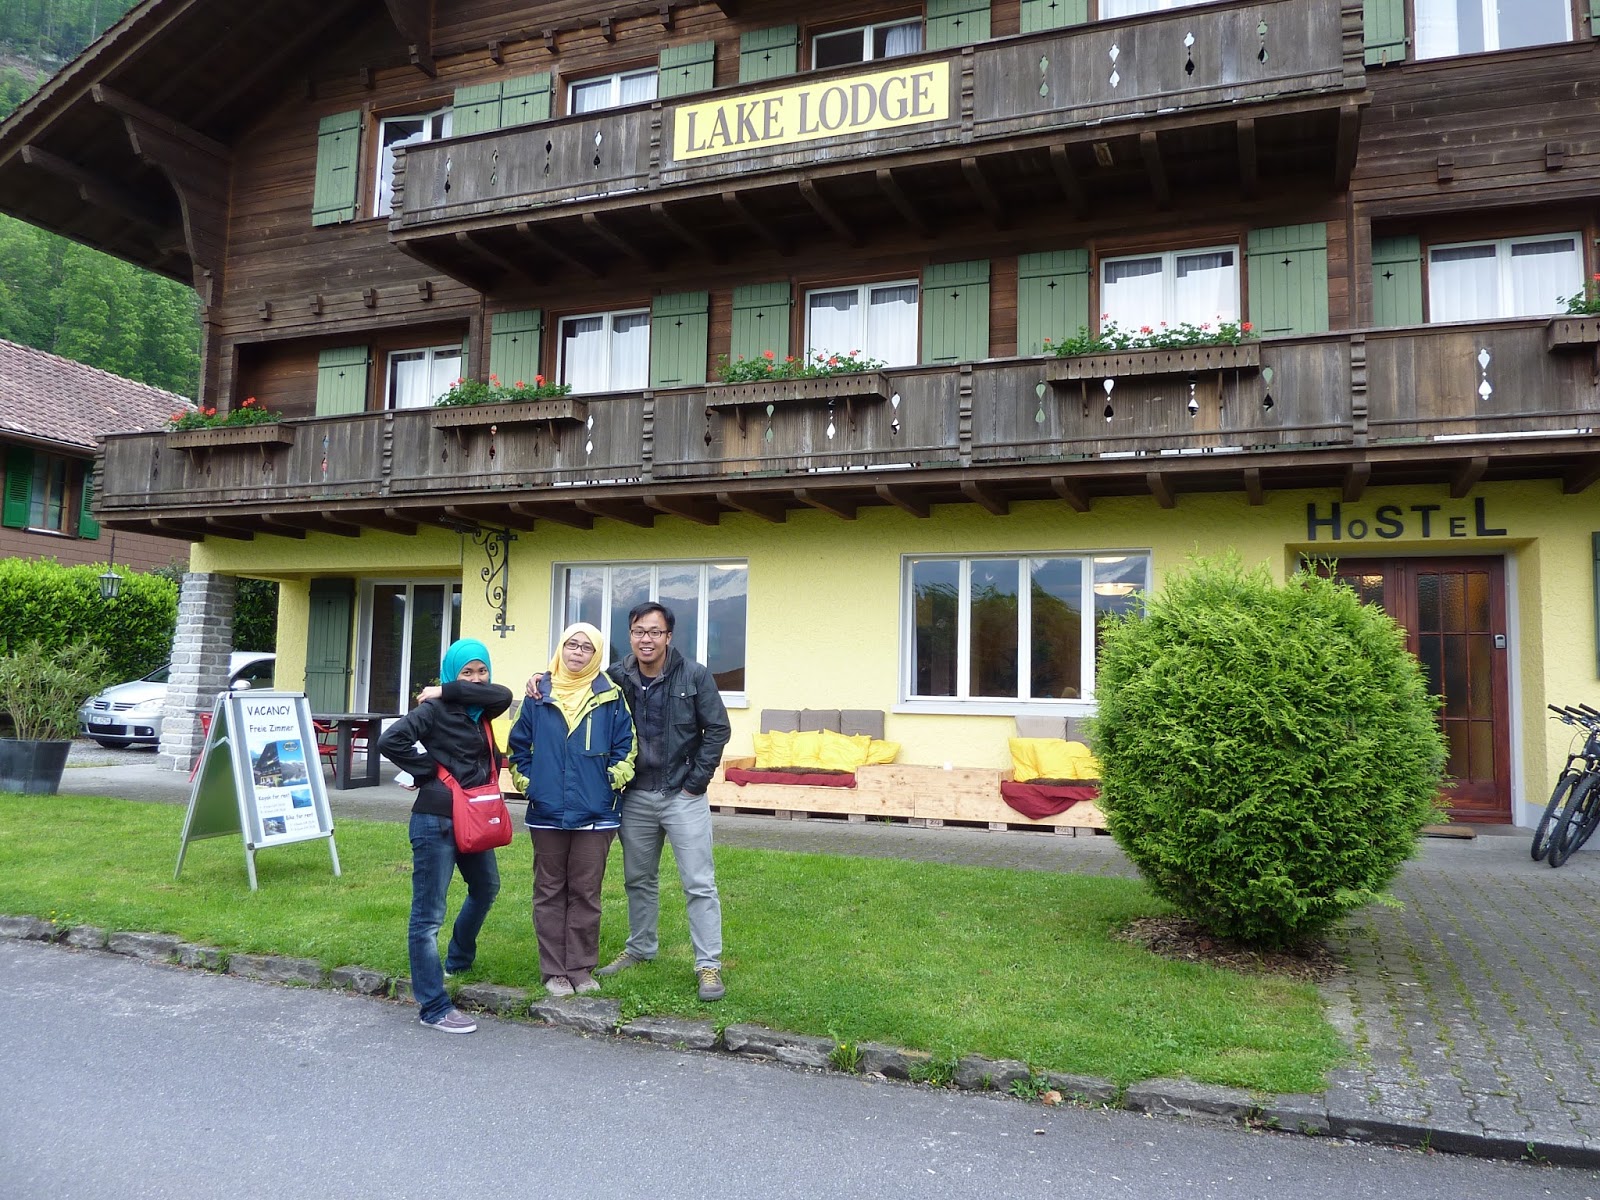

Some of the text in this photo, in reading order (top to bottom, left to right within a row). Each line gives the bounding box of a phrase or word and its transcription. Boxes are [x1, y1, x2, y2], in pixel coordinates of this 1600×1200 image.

[685, 71, 935, 153] LAKE LODGE
[247, 706, 290, 716] VACANCY
[249, 724, 294, 733] Freie Zimmer
